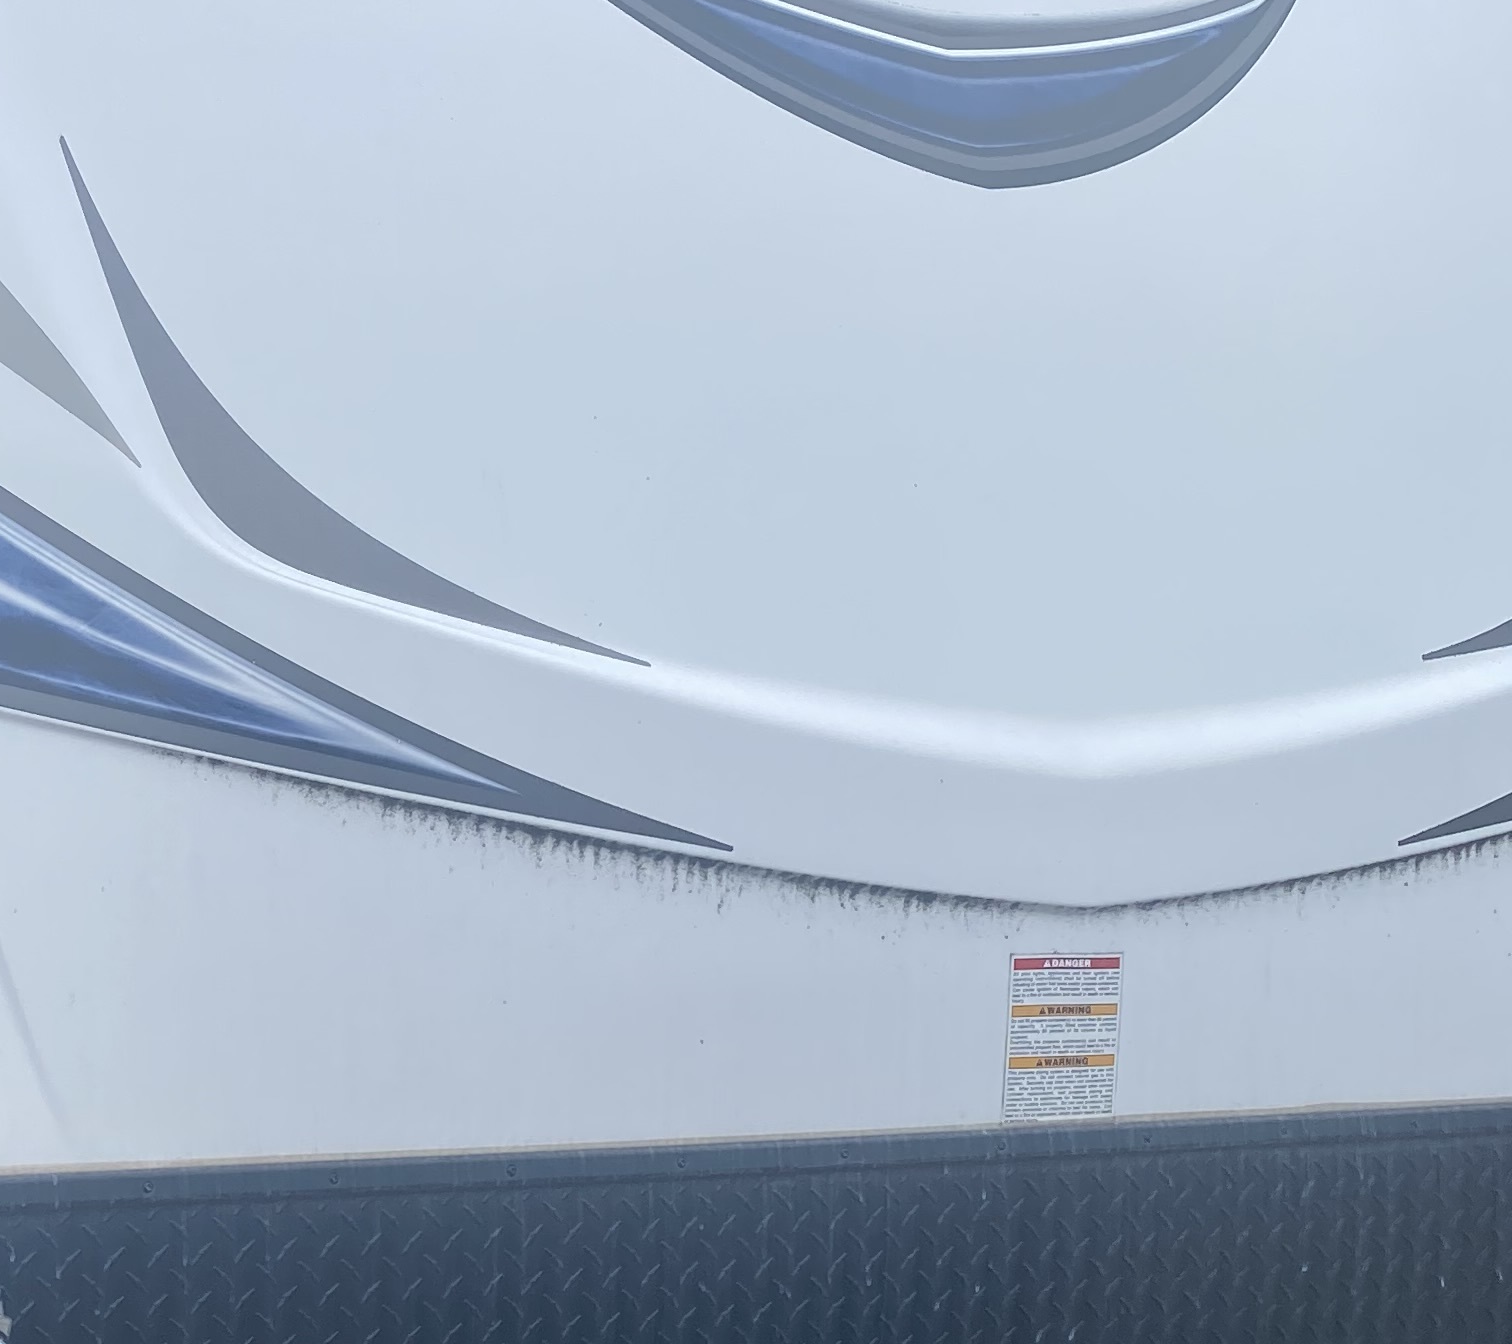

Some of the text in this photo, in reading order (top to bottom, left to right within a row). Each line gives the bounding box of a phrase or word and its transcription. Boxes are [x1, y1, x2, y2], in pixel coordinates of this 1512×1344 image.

[1052, 958, 1092, 968] DANGER
[1046, 1006, 1092, 1015] WARNING
[1044, 1057, 1089, 1067] WARNING
